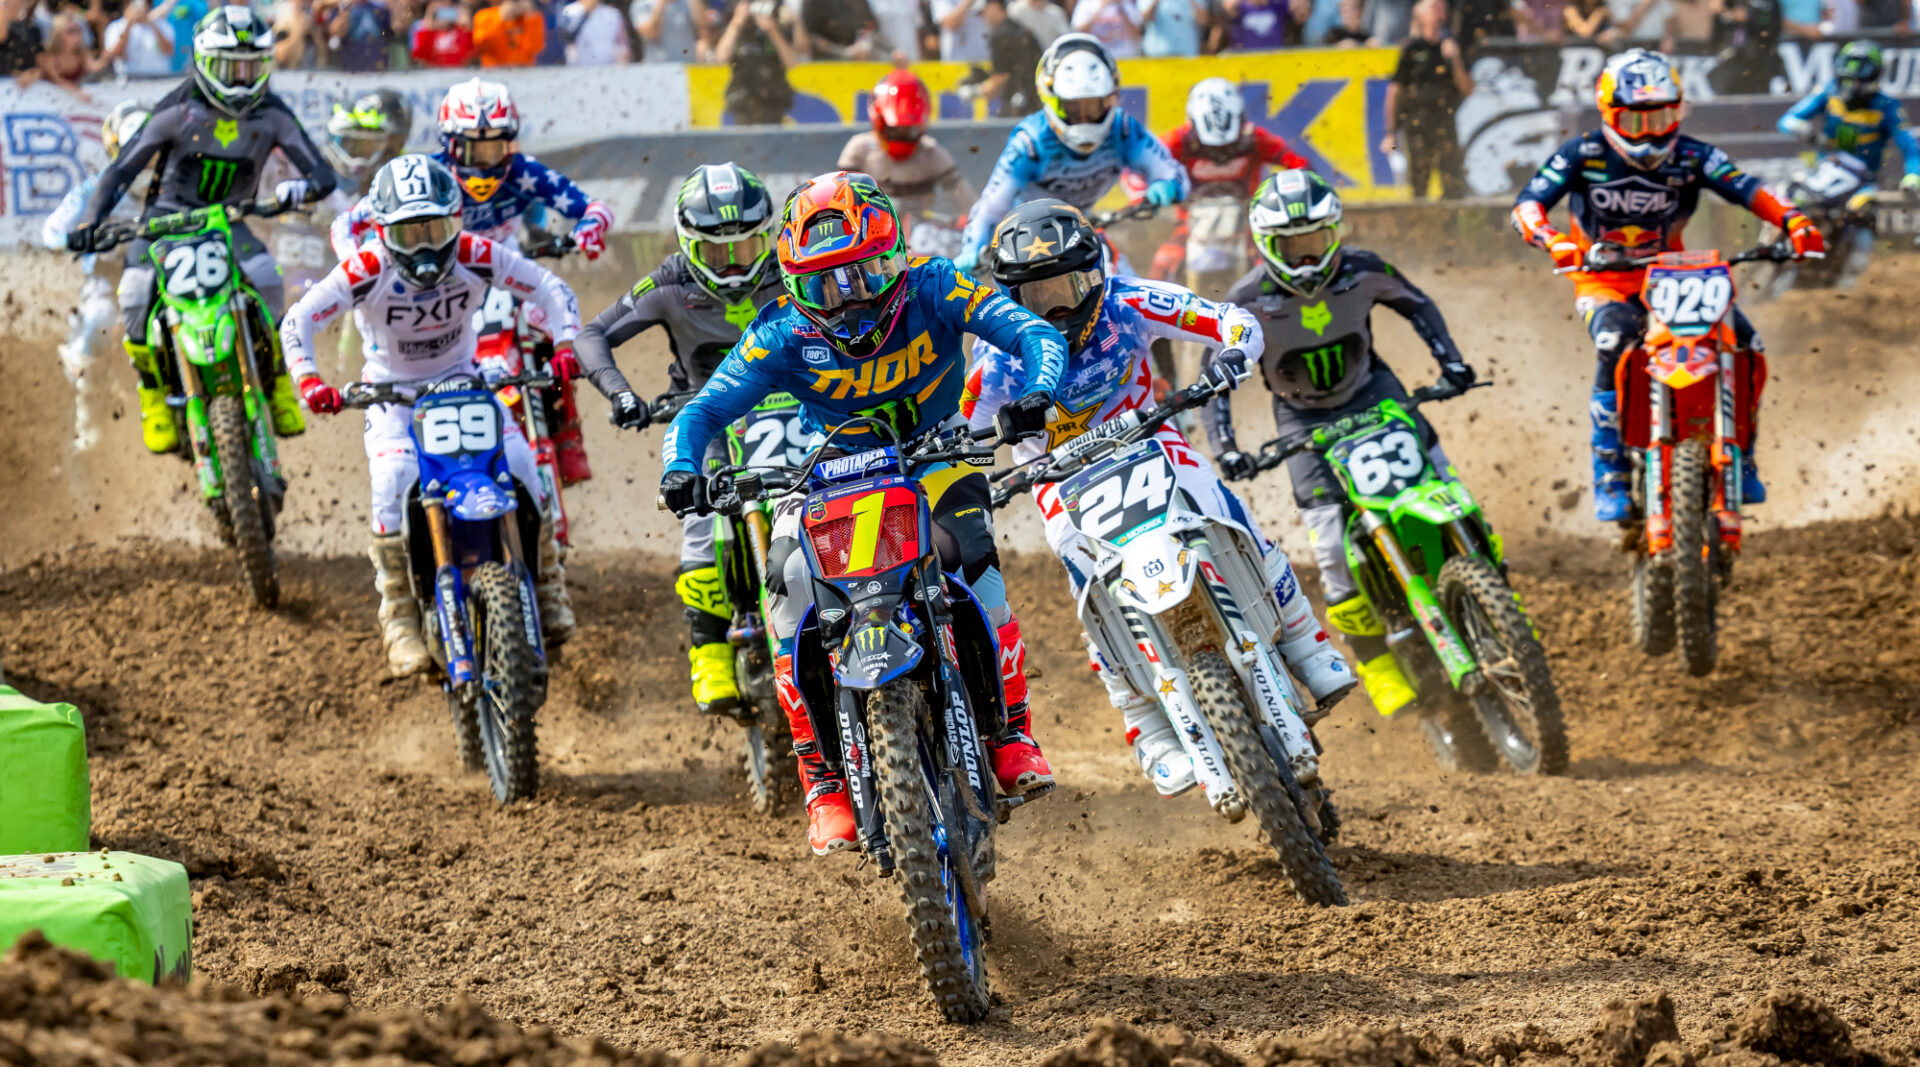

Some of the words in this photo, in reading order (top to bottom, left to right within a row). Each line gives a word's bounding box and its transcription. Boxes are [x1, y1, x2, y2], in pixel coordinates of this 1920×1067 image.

[164, 241, 229, 295] 26
[386, 289, 469, 326] FXR
[1651, 275, 1732, 323] 929
[806, 349, 827, 360] 100%
[808, 329, 938, 400] THOR
[422, 403, 497, 454] 69
[744, 417, 815, 475] 29
[1348, 431, 1424, 495] 63
[955, 507, 981, 518] SPORT
[1079, 452, 1172, 537] 24
[843, 491, 886, 575] 1
[1126, 518, 1163, 540] MOTOREX
[862, 661, 888, 673] YAMAHA
[944, 708, 958, 743] CYCRA
[1252, 662, 1287, 736] DUNLOP
[839, 711, 864, 809] DUNLOP
[860, 742, 871, 778] CYCRA
[951, 691, 981, 789] DUNLOP
[1181, 714, 1220, 776] DULOP
